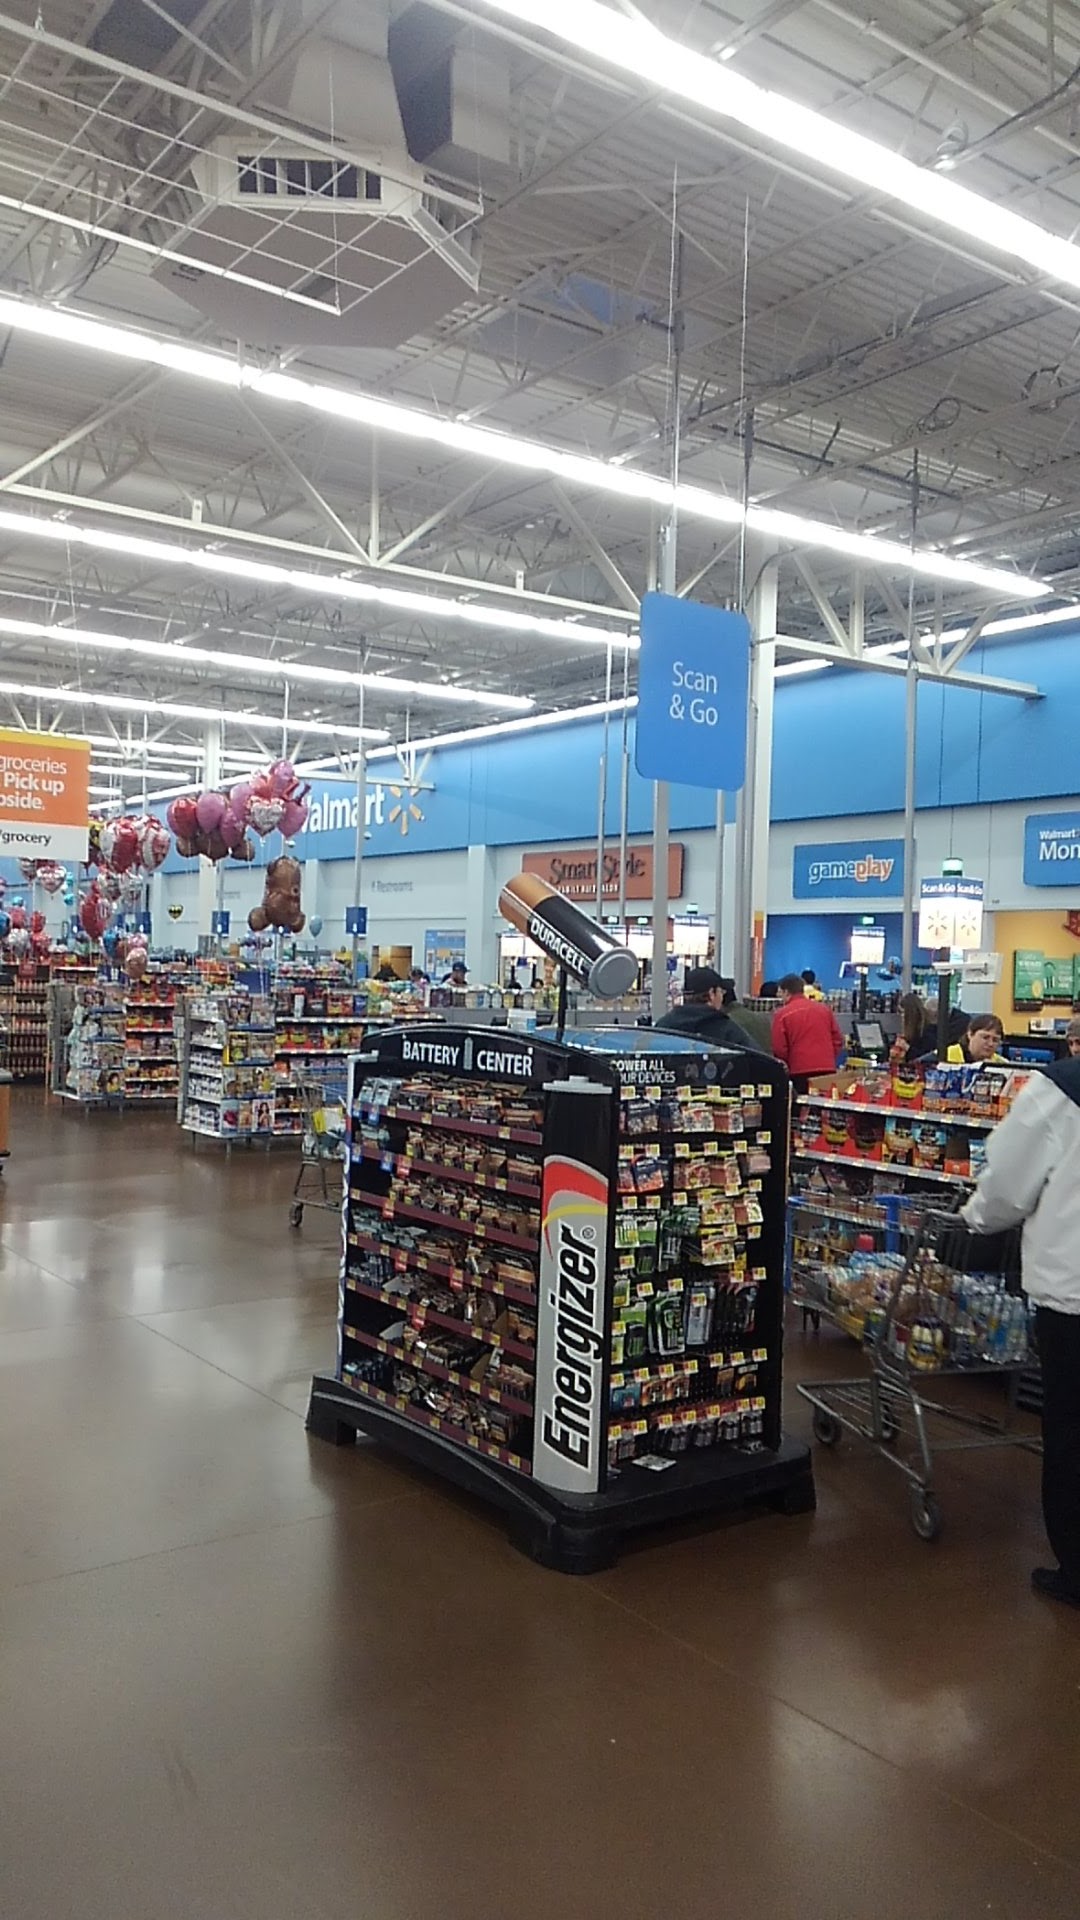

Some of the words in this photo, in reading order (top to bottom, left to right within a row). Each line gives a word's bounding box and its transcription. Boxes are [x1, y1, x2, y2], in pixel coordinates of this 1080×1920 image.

[672, 661, 717, 694] Scan
[669, 693, 685, 720] &
[690, 698, 718, 726] Go
[0, 755, 67, 775] groceries
[4, 772, 39, 790] Pick
[42, 779, 65, 796] up
[1039, 829, 1075, 840] Walmart
[808, 854, 894, 884] gameplay
[530, 917, 585, 975] DURACELL
[402, 1041, 459, 1067] BATTERY
[476, 1050, 533, 1077] CENTER
[649, 1059, 666, 1071] ALL
[638, 1070, 677, 1085] DEVICES
[543, 1220, 603, 1471] Energizer
